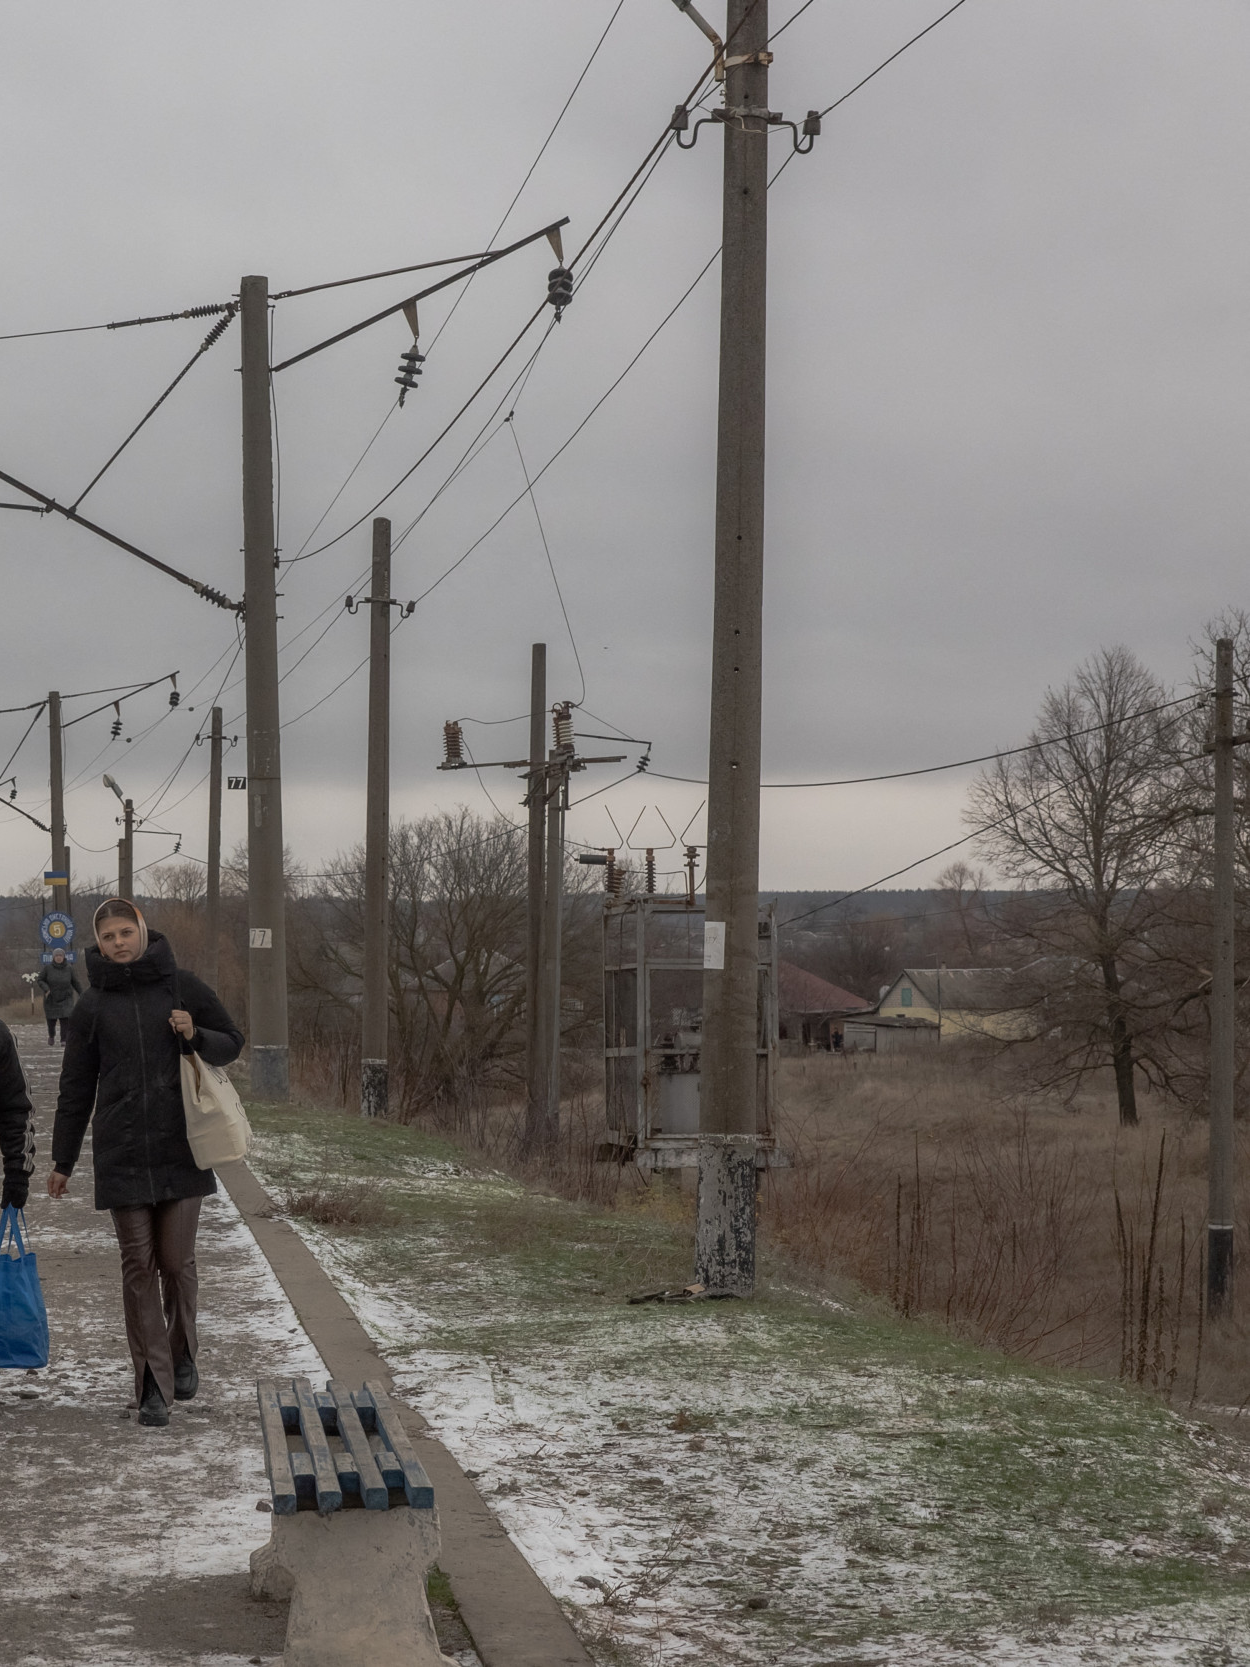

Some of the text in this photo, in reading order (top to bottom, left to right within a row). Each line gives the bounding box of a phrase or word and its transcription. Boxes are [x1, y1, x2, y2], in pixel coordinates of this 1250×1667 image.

[228, 777, 245, 789] 77
[53, 924, 61, 936] 5
[250, 929, 266, 947] 77
[42, 953, 74, 962] ПІВНА
